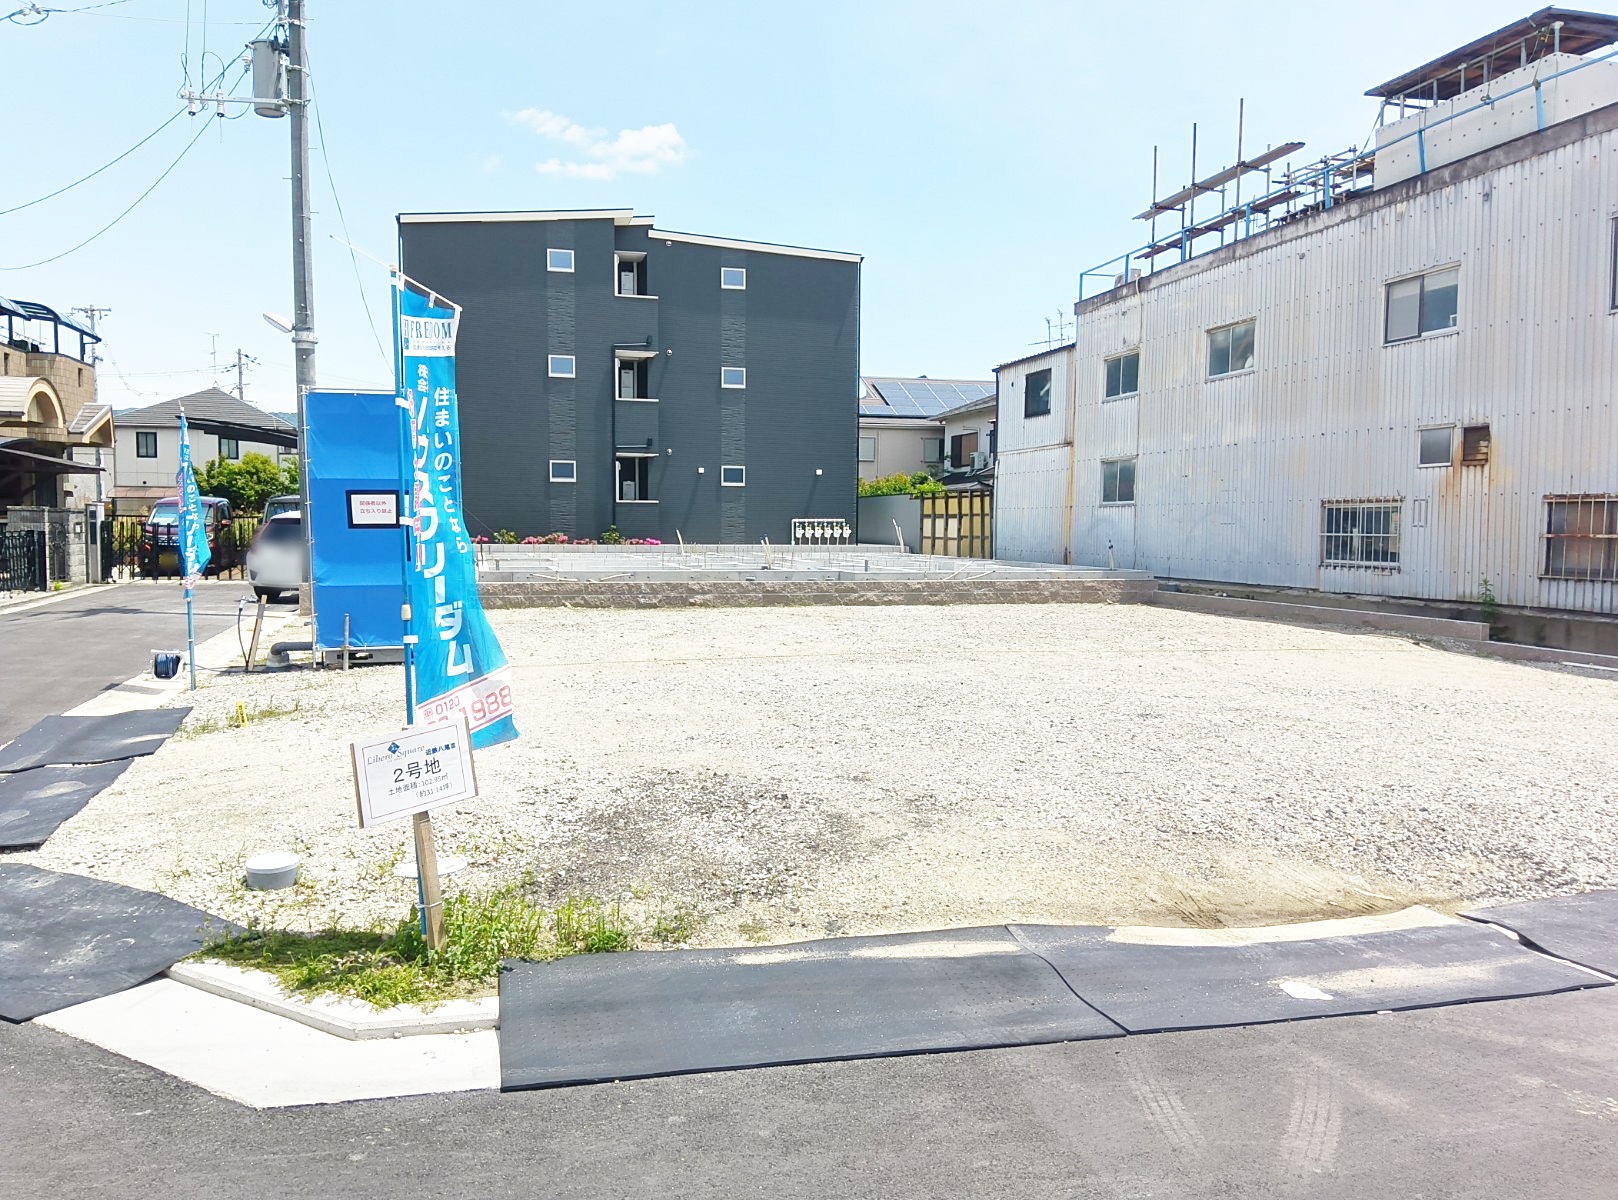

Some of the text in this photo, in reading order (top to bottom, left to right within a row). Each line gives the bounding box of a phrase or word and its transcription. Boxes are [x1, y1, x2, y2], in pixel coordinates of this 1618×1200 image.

[434, 386, 468, 554] 住まいのことなら
[435, 696, 460, 714] 0120
[367, 752, 393, 765] Libero
[396, 744, 425, 760] Square
[393, 757, 442, 784] 2号地
